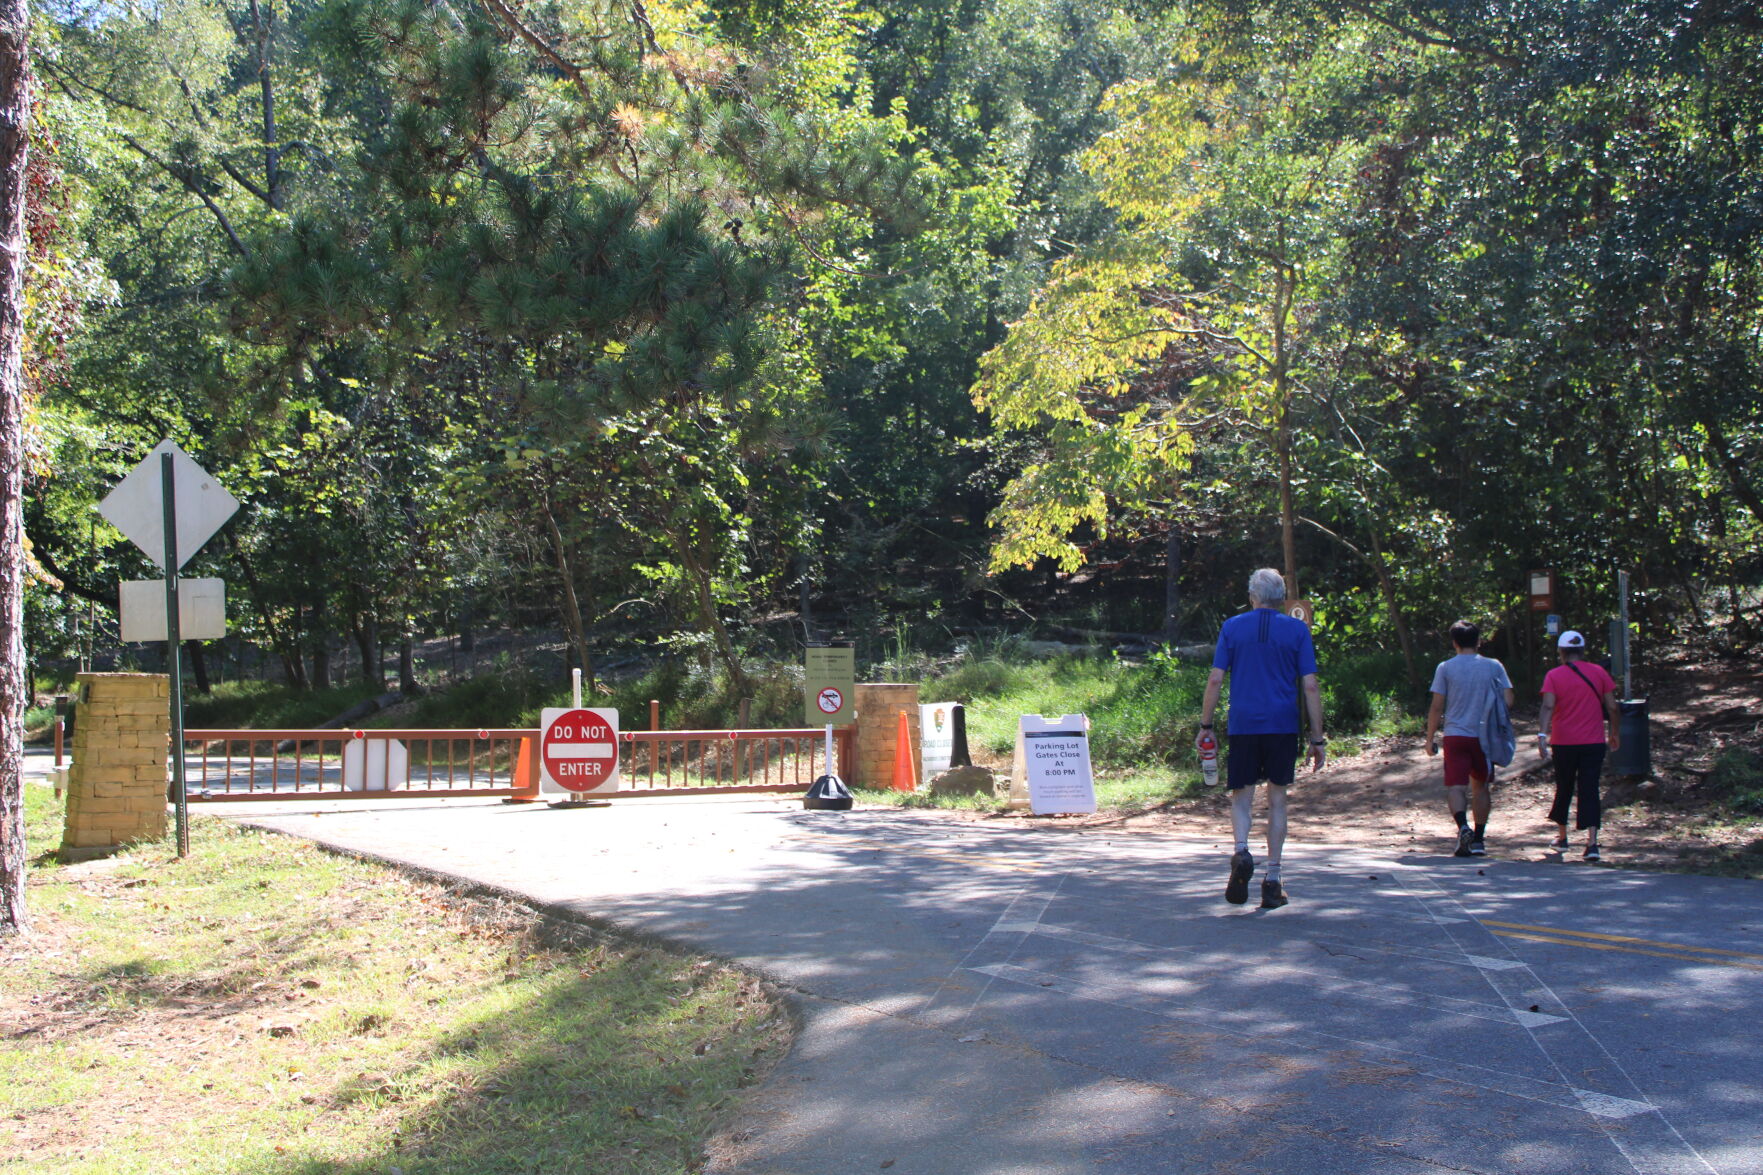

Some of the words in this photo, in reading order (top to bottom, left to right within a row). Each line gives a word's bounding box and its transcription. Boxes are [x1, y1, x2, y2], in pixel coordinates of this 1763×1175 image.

[554, 726, 572, 738] DO
[582, 726, 606, 738] NOT
[560, 762, 602, 776] ENTER
